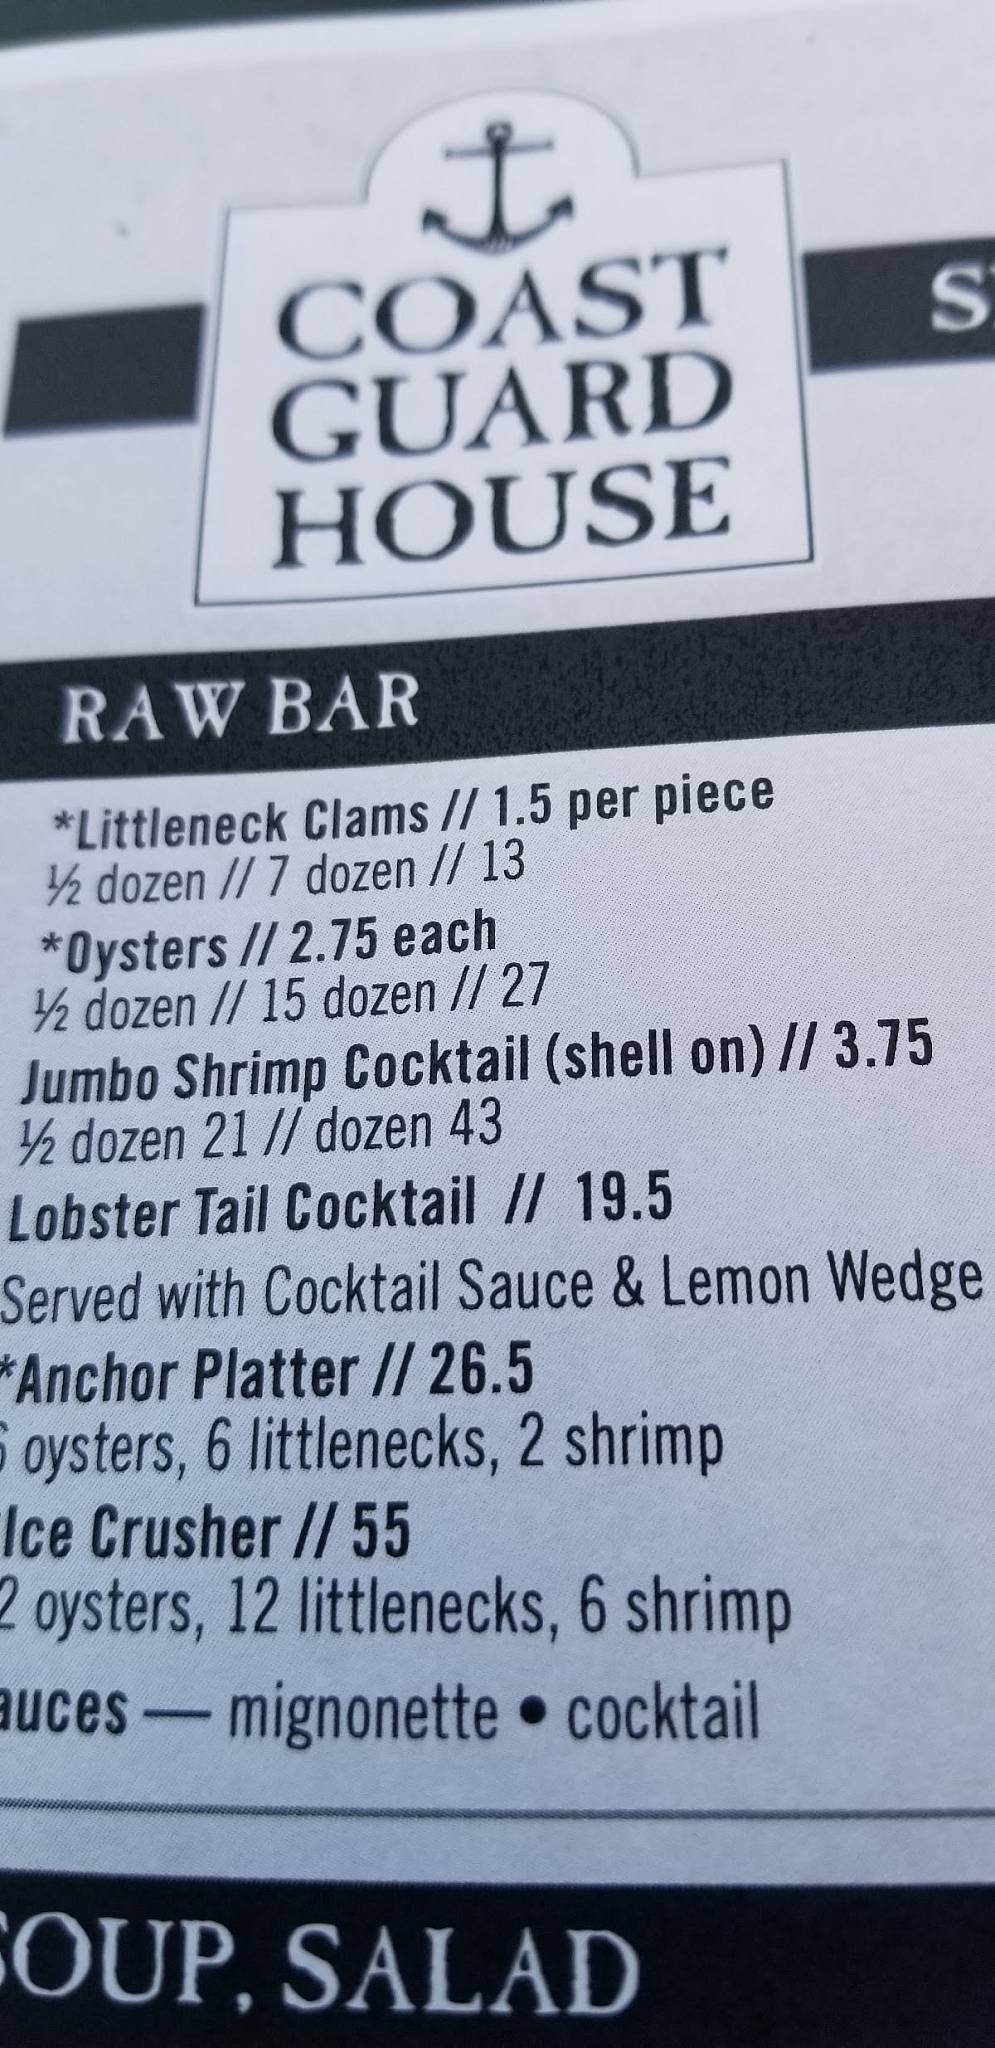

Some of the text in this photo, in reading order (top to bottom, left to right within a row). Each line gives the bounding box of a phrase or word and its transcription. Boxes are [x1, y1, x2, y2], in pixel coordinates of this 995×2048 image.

[276, 246, 729, 363] COAST
[931, 261, 995, 332] S
[271, 349, 735, 464] GUARD
[272, 456, 732, 570] HOUSE
[63, 672, 419, 744] RAW BAR
[304, 798, 429, 841] Clams
[494, 782, 552, 827] 1.5
[569, 785, 640, 831] per
[654, 772, 774, 826] piece
[96, 862, 206, 905] dozen
[269, 854, 290, 897] 7
[306, 852, 415, 896] dozen
[483, 837, 525, 882] 13
[289, 915, 378, 964] 2.75
[393, 907, 496, 958] each
[84, 987, 196, 1032] dozen
[262, 976, 306, 1023] 15
[323, 974, 436, 1020] dozen
[501, 960, 550, 1008] 27
[20, 1056, 159, 1106] Jumbo
[173, 1049, 327, 1103] Shrimp
[344, 1034, 529, 1090] Cocktail
[545, 1028, 673, 1086] (shell
[690, 1023, 765, 1078] on)
[833, 1017, 933, 1069] 3.75
[71, 1117, 185, 1165] dozen
[202, 1109, 248, 1159] 21
[315, 1105, 432, 1154] dozen
[449, 1096, 502, 1146] 43
[8, 1193, 181, 1243] Lobster
[194, 1184, 269, 1236] Tail
[285, 1175, 475, 1232] Cocktail
[576, 1169, 672, 1222] 19.5
[0, 1247, 983, 1326] Served with Cocktail Sauce & Lemon Wedge
[193, 1347, 360, 1400] Platter
[429, 1340, 533, 1395] 26.5
[24, 1421, 186, 1485] oysters,
[206, 1416, 232, 1473] 6
[250, 1412, 498, 1477] littlenecks,
[519, 1410, 544, 1467] 2
[565, 1409, 724, 1477] shrimp
[91, 1503, 282, 1560] Crusher
[352, 1501, 410, 1559] 55
[35, 1578, 204, 1643] oysters,
[229, 1575, 279, 1634] 12
[300, 1575, 558, 1643] littlenecks,
[580, 1573, 607, 1634] 6
[626, 1573, 792, 1645] shrimp
[229, 1680, 499, 1751] mignonette
[567, 1680, 759, 1741] cocktail
[0, 1910, 639, 2015] OUP, SALAD
